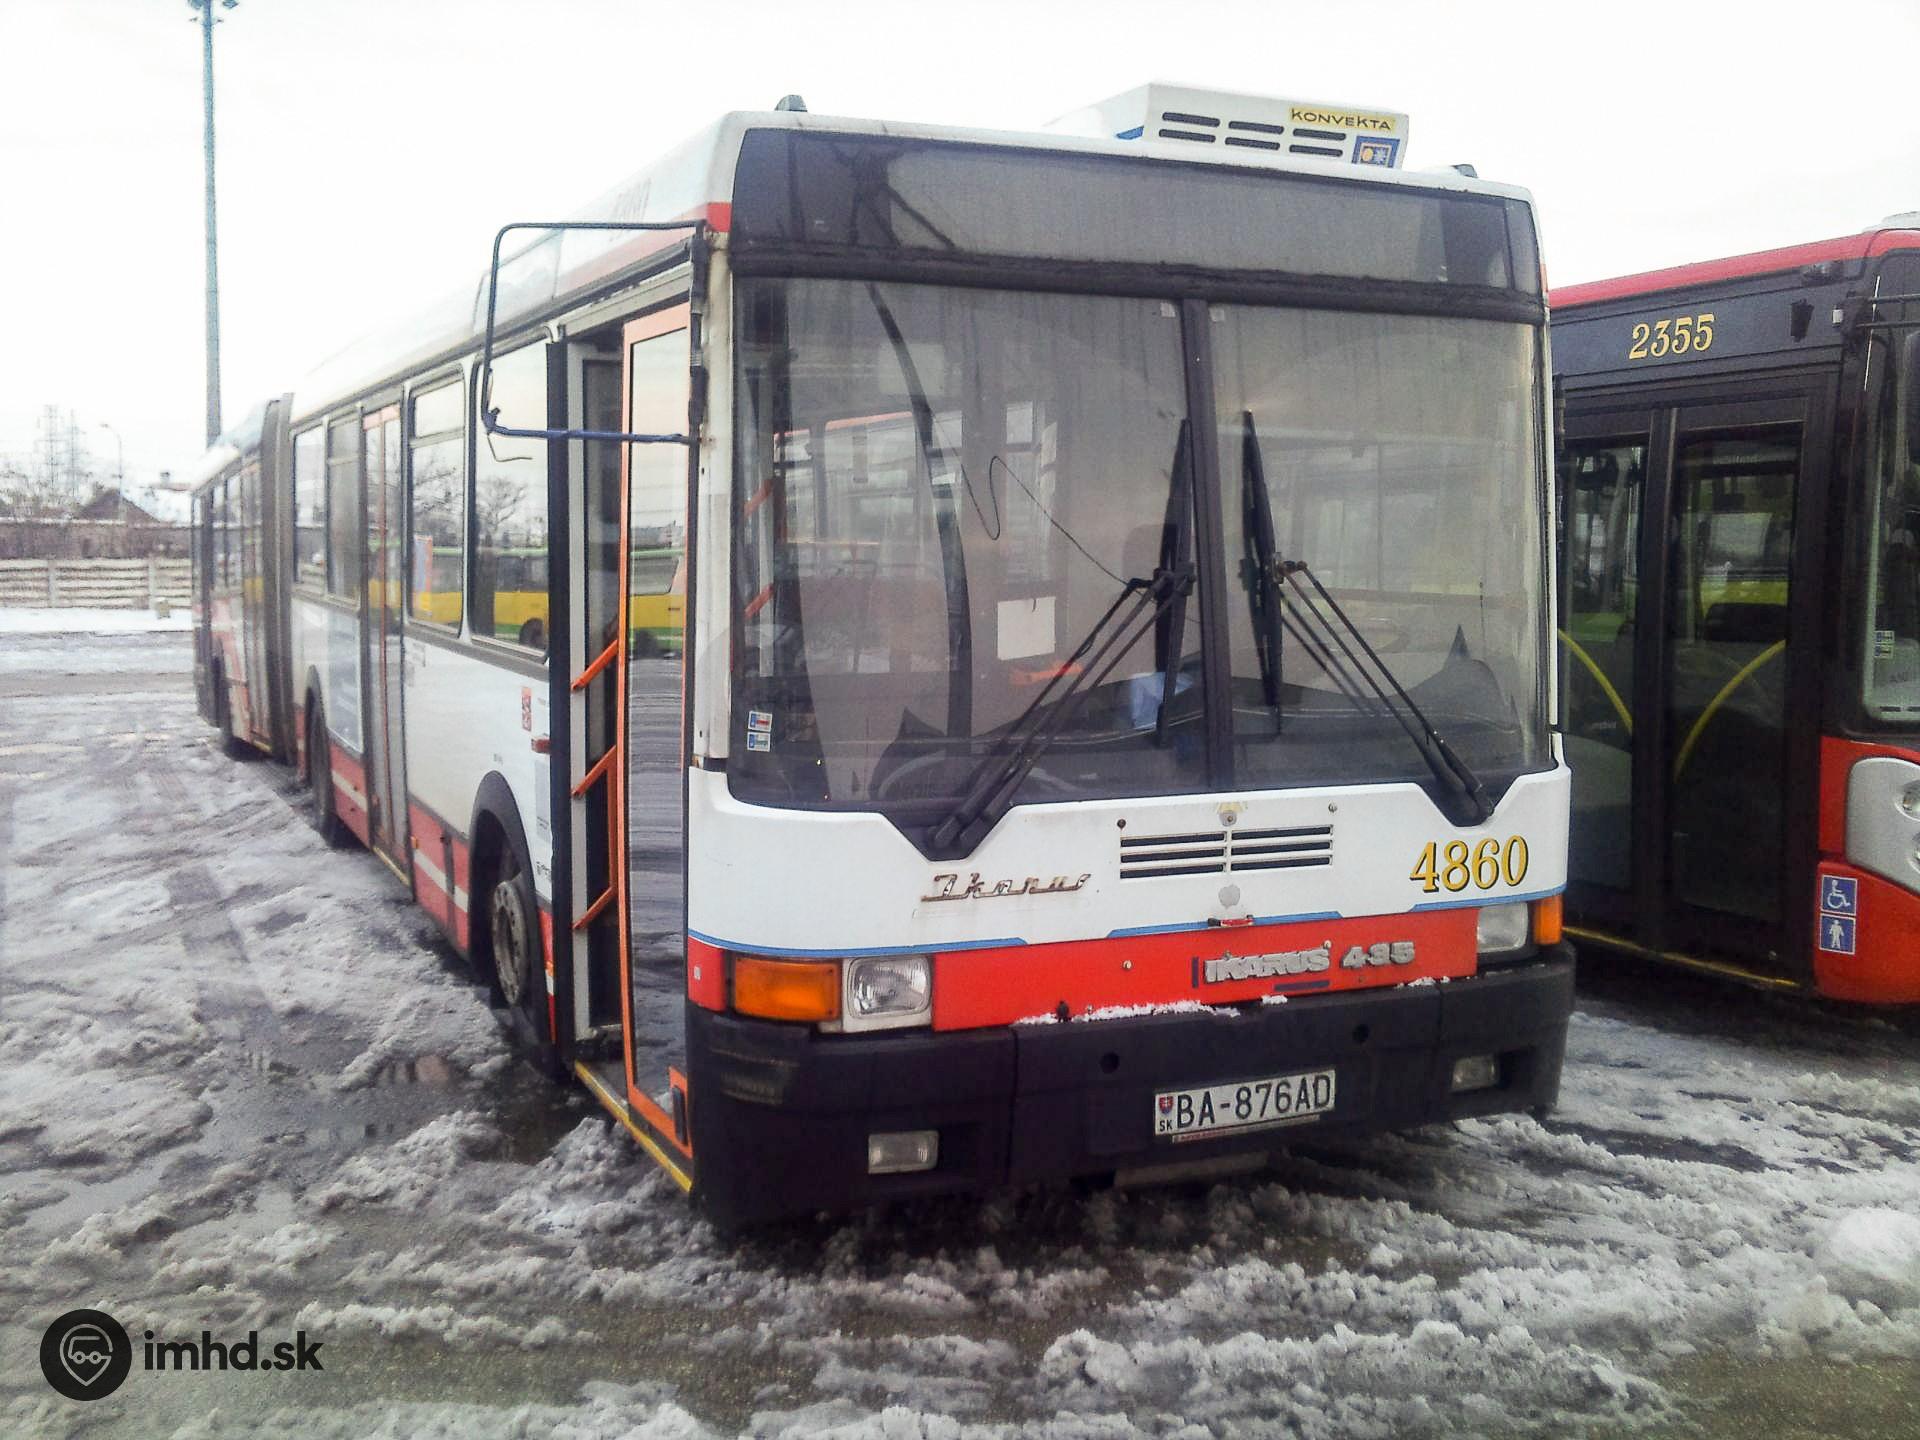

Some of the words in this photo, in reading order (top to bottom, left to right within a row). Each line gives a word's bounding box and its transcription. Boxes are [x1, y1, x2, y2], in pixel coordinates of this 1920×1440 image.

[1291, 108, 1392, 131] KONVEKTA
[1628, 313, 1716, 360] 2355
[1410, 834, 1529, 893] 4860
[1203, 948, 1331, 984] IKARUS
[1340, 941, 1415, 970] 435
[1176, 1074, 1332, 1130] BA-876AD
[1158, 1119, 1173, 1132] SK
